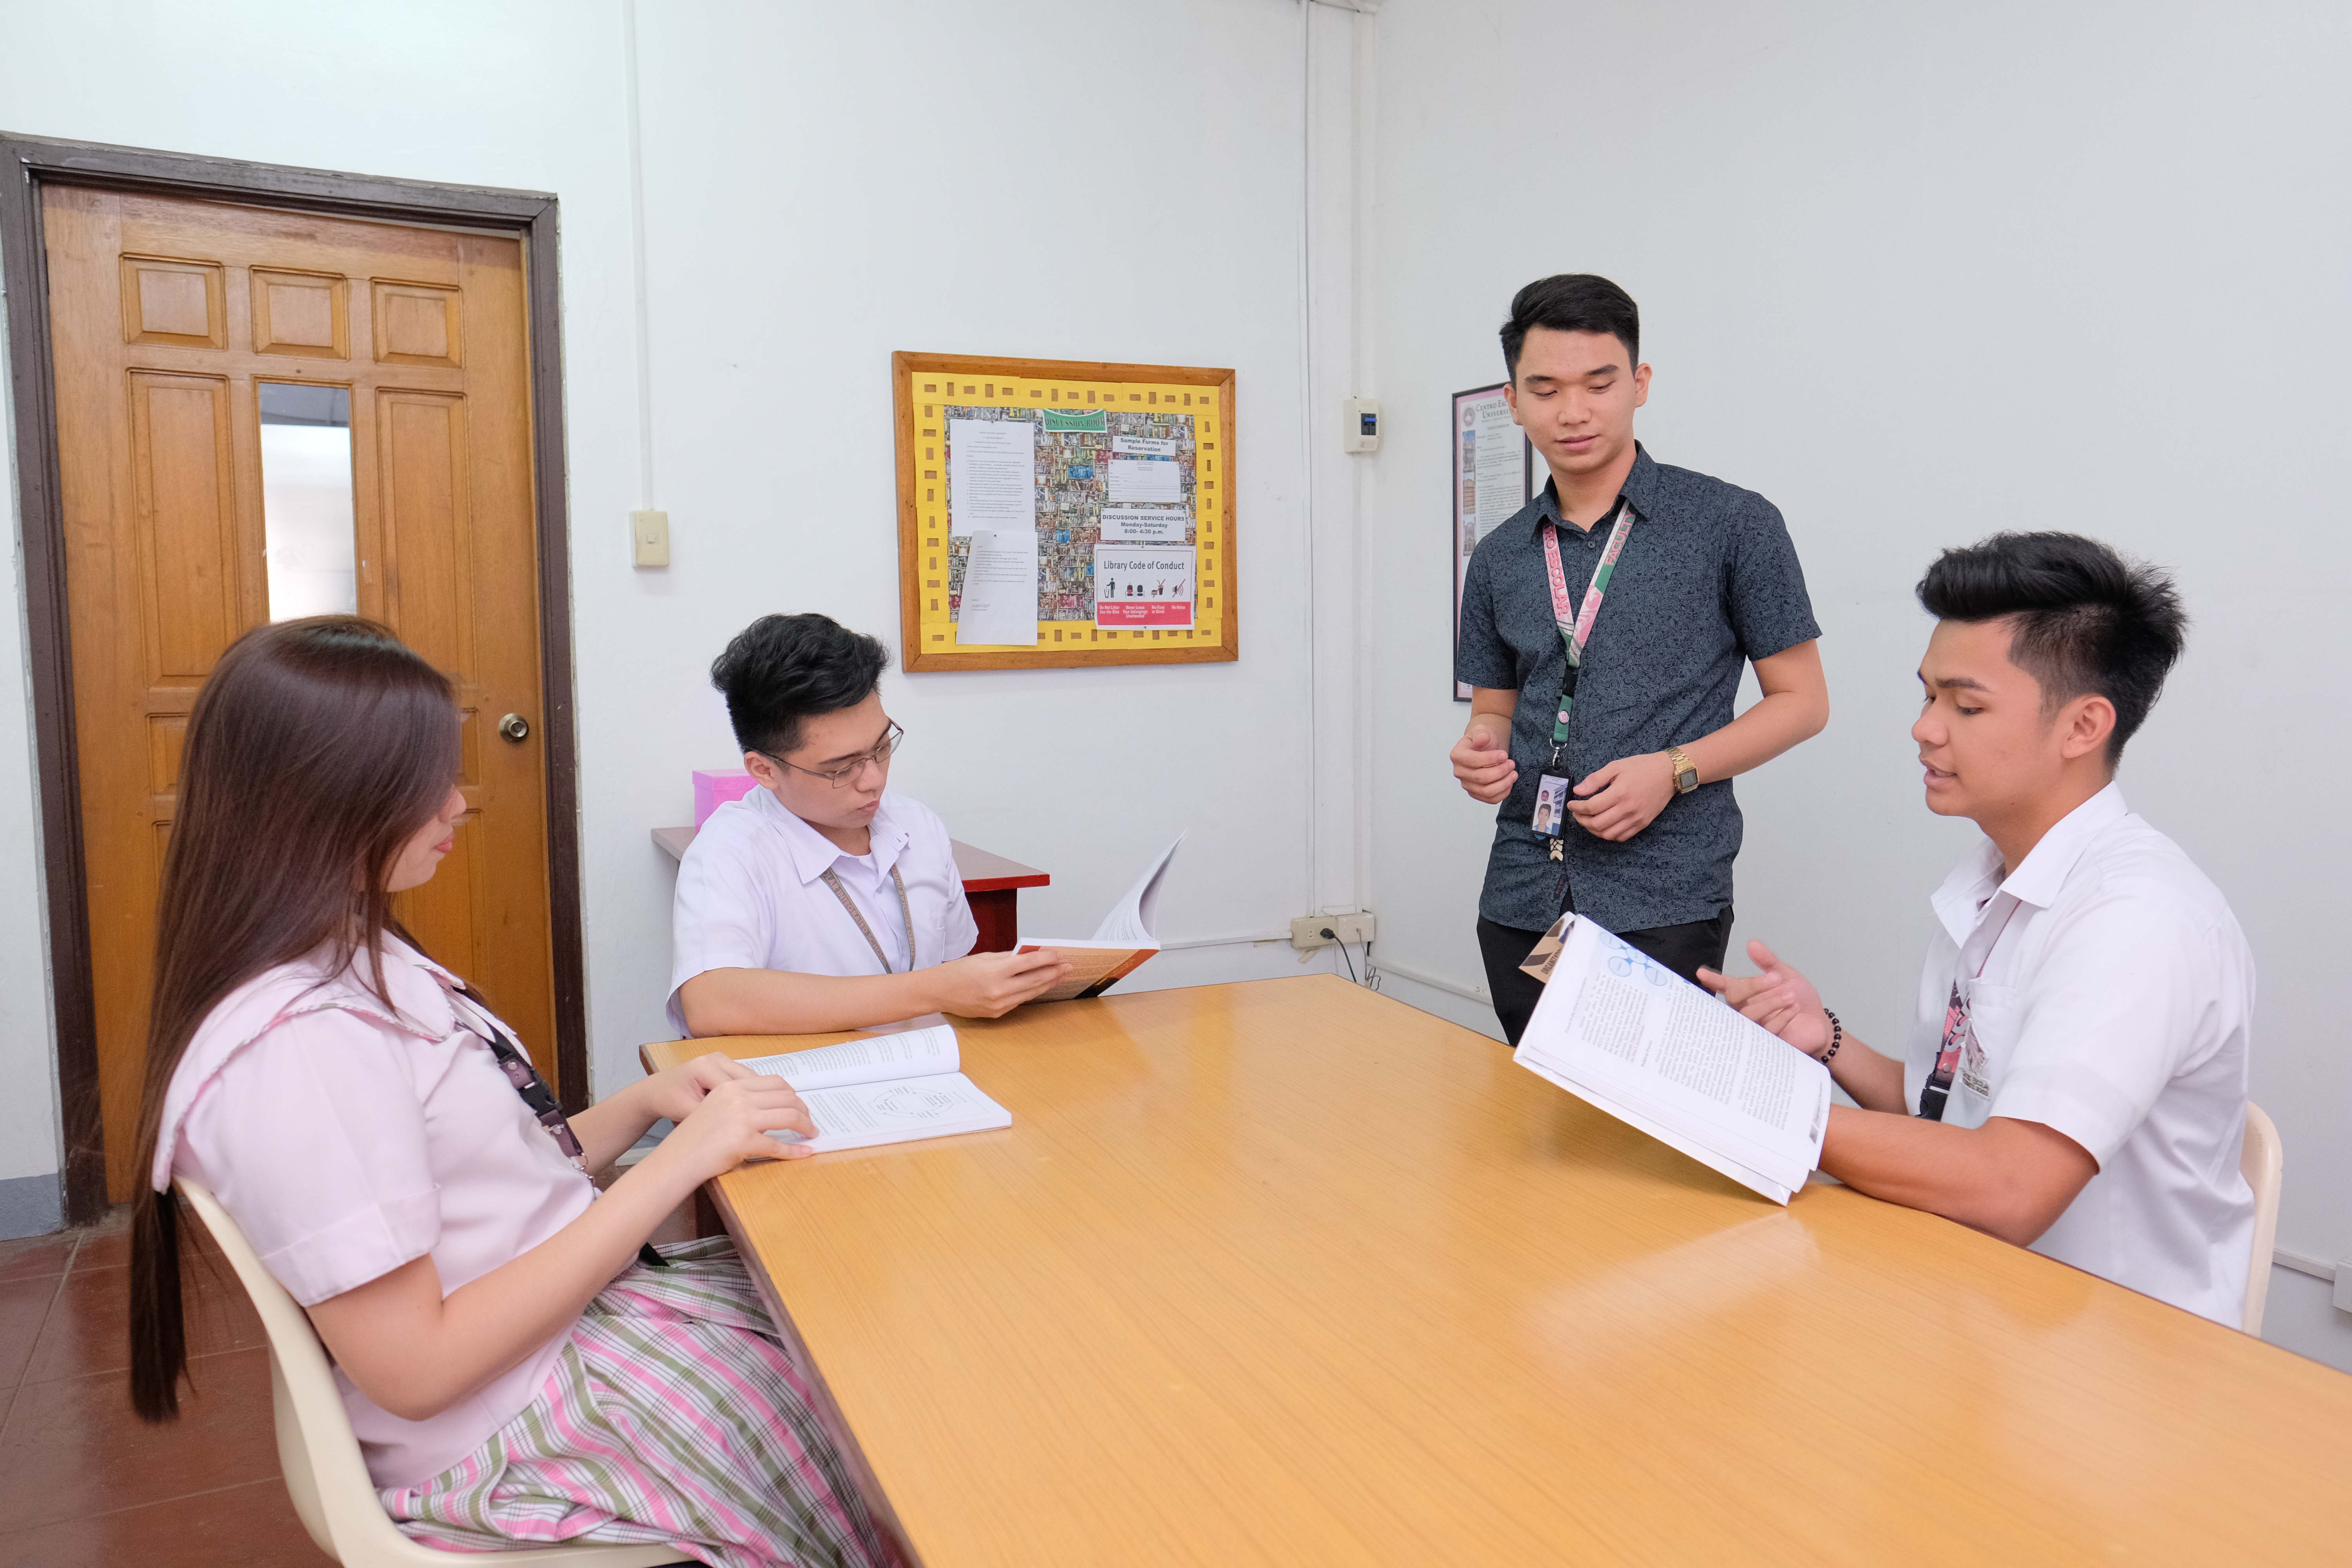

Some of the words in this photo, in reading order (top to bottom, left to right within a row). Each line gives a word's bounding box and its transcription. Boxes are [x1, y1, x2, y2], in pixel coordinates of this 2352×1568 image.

[1476, 402, 1497, 412] CENTRO
[1483, 409, 1508, 419] UNIVERSI
[1045, 414, 1084, 427] DISCUSSION
[1087, 415, 1105, 427] ROOM
[1544, 523, 1556, 549] TRO
[1604, 509, 1636, 566] FACULTY
[1104, 561, 1127, 571] Library
[1129, 561, 1145, 570] Code
[1147, 561, 1154, 570] of
[1156, 561, 1185, 570] Conduct
[1548, 548, 1570, 616] ESCOLAR
[822, 870, 839, 891] OLAR
[836, 889, 868, 933] INTEGRATED
